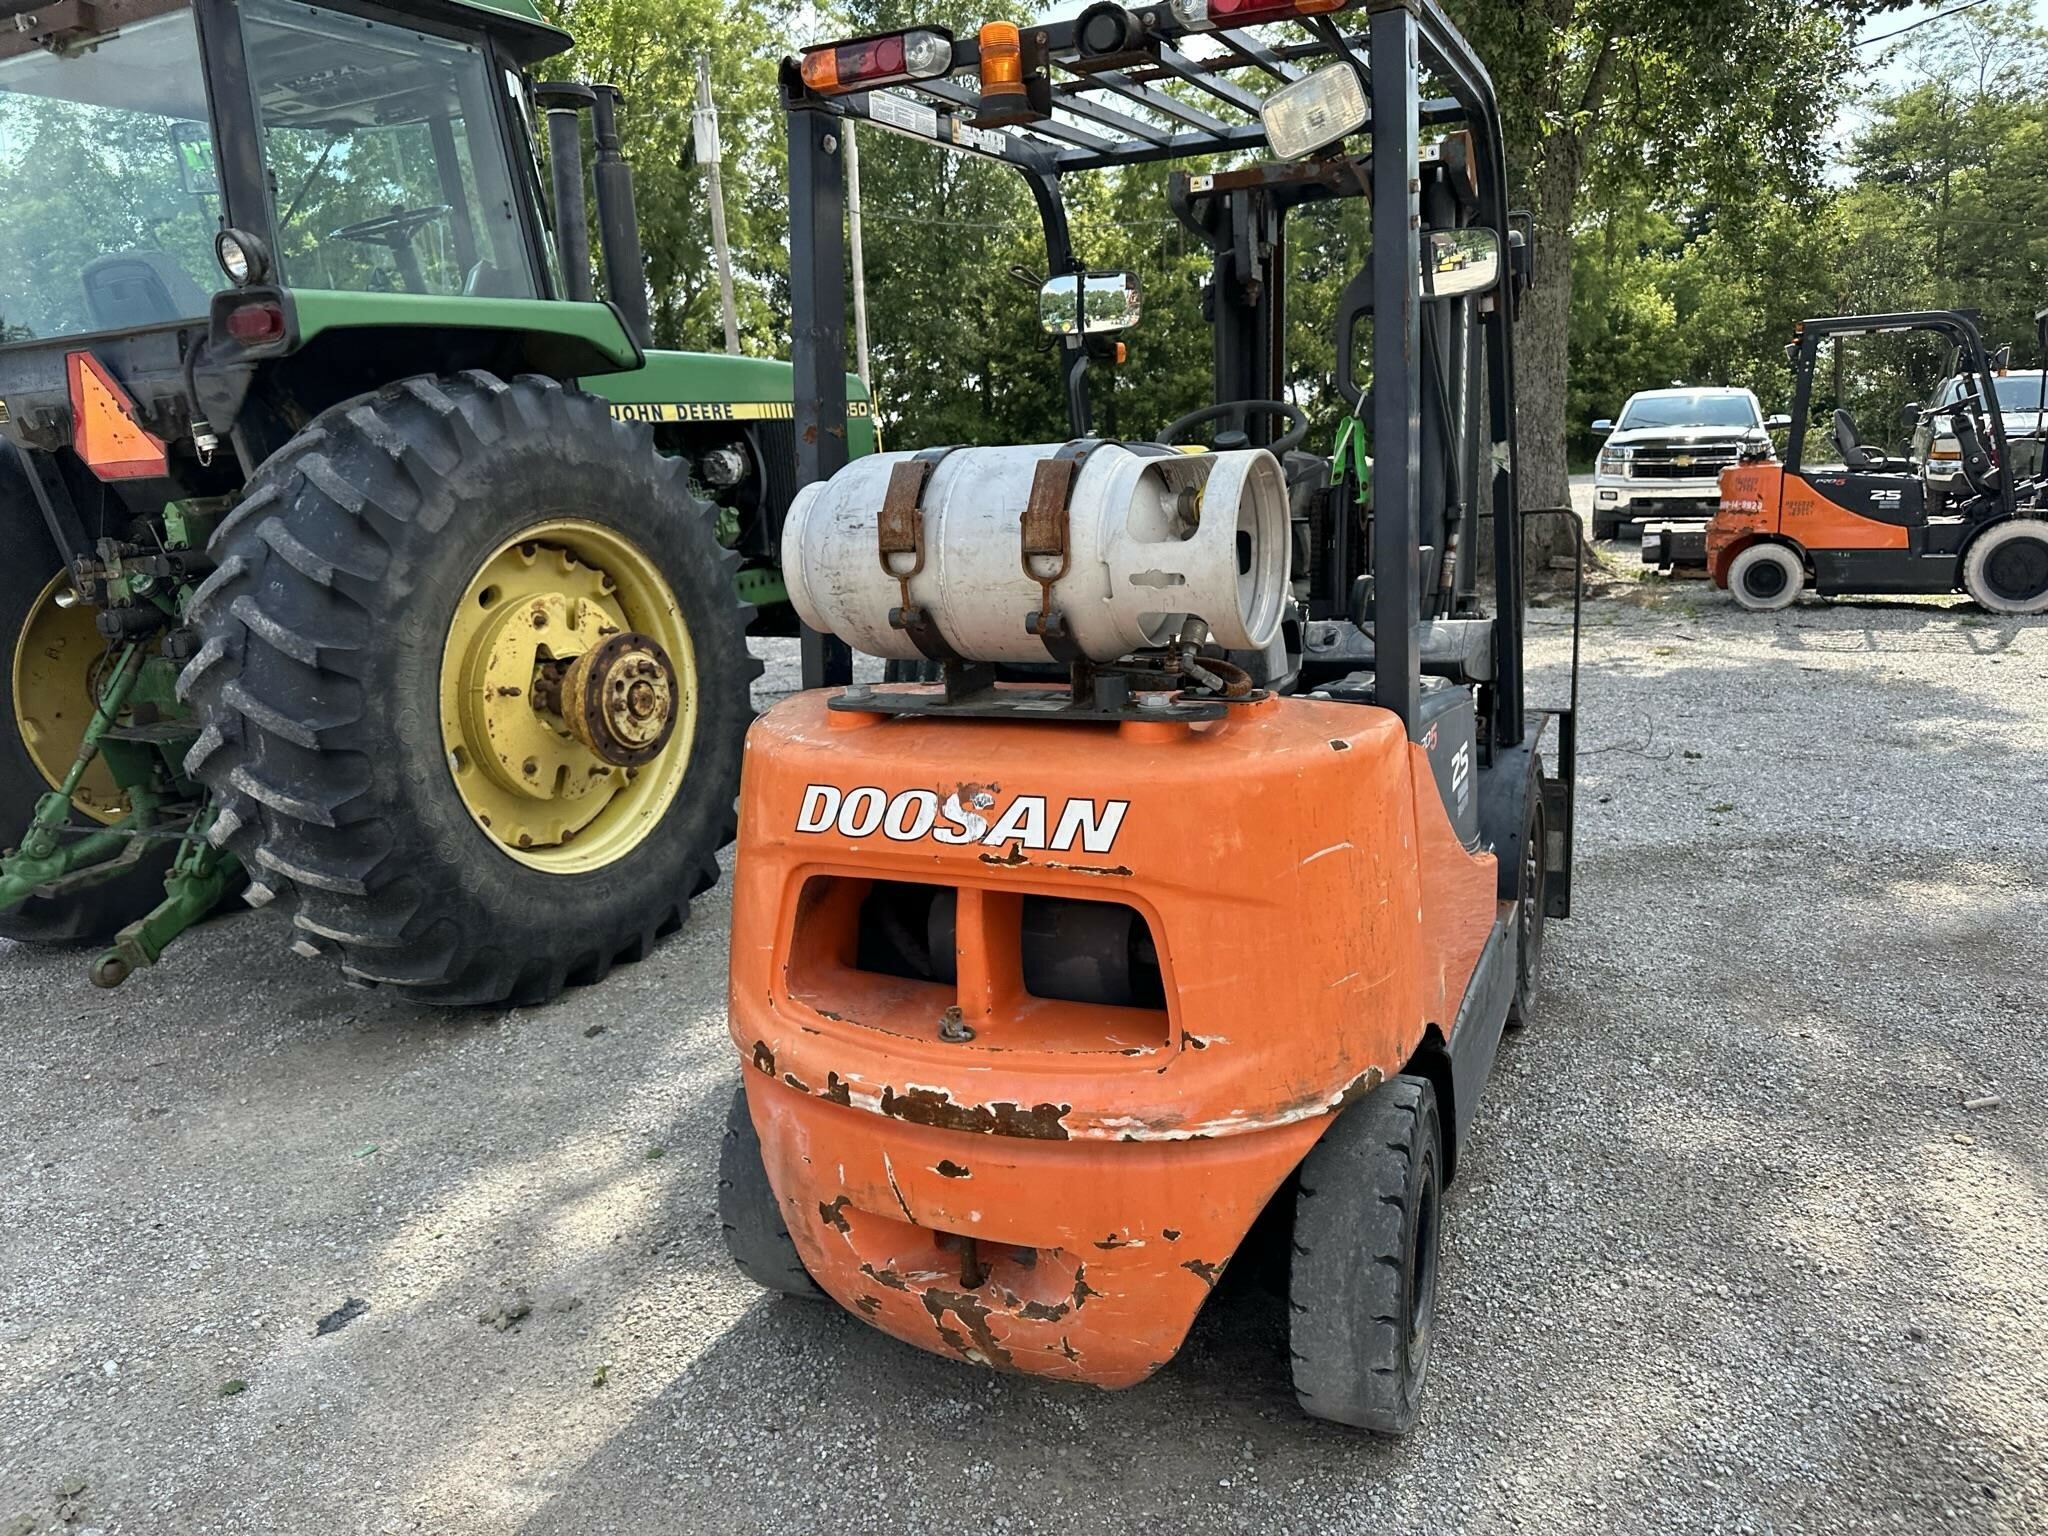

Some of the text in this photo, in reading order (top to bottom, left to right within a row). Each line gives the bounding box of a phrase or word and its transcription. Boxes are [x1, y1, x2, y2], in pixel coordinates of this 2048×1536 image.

[611, 403, 734, 421] JOHN DEERE
[847, 401, 868, 417] 50
[1869, 489, 1902, 501] 25
[1451, 740, 1469, 793] 25
[795, 783, 1131, 854] DOOSAN
